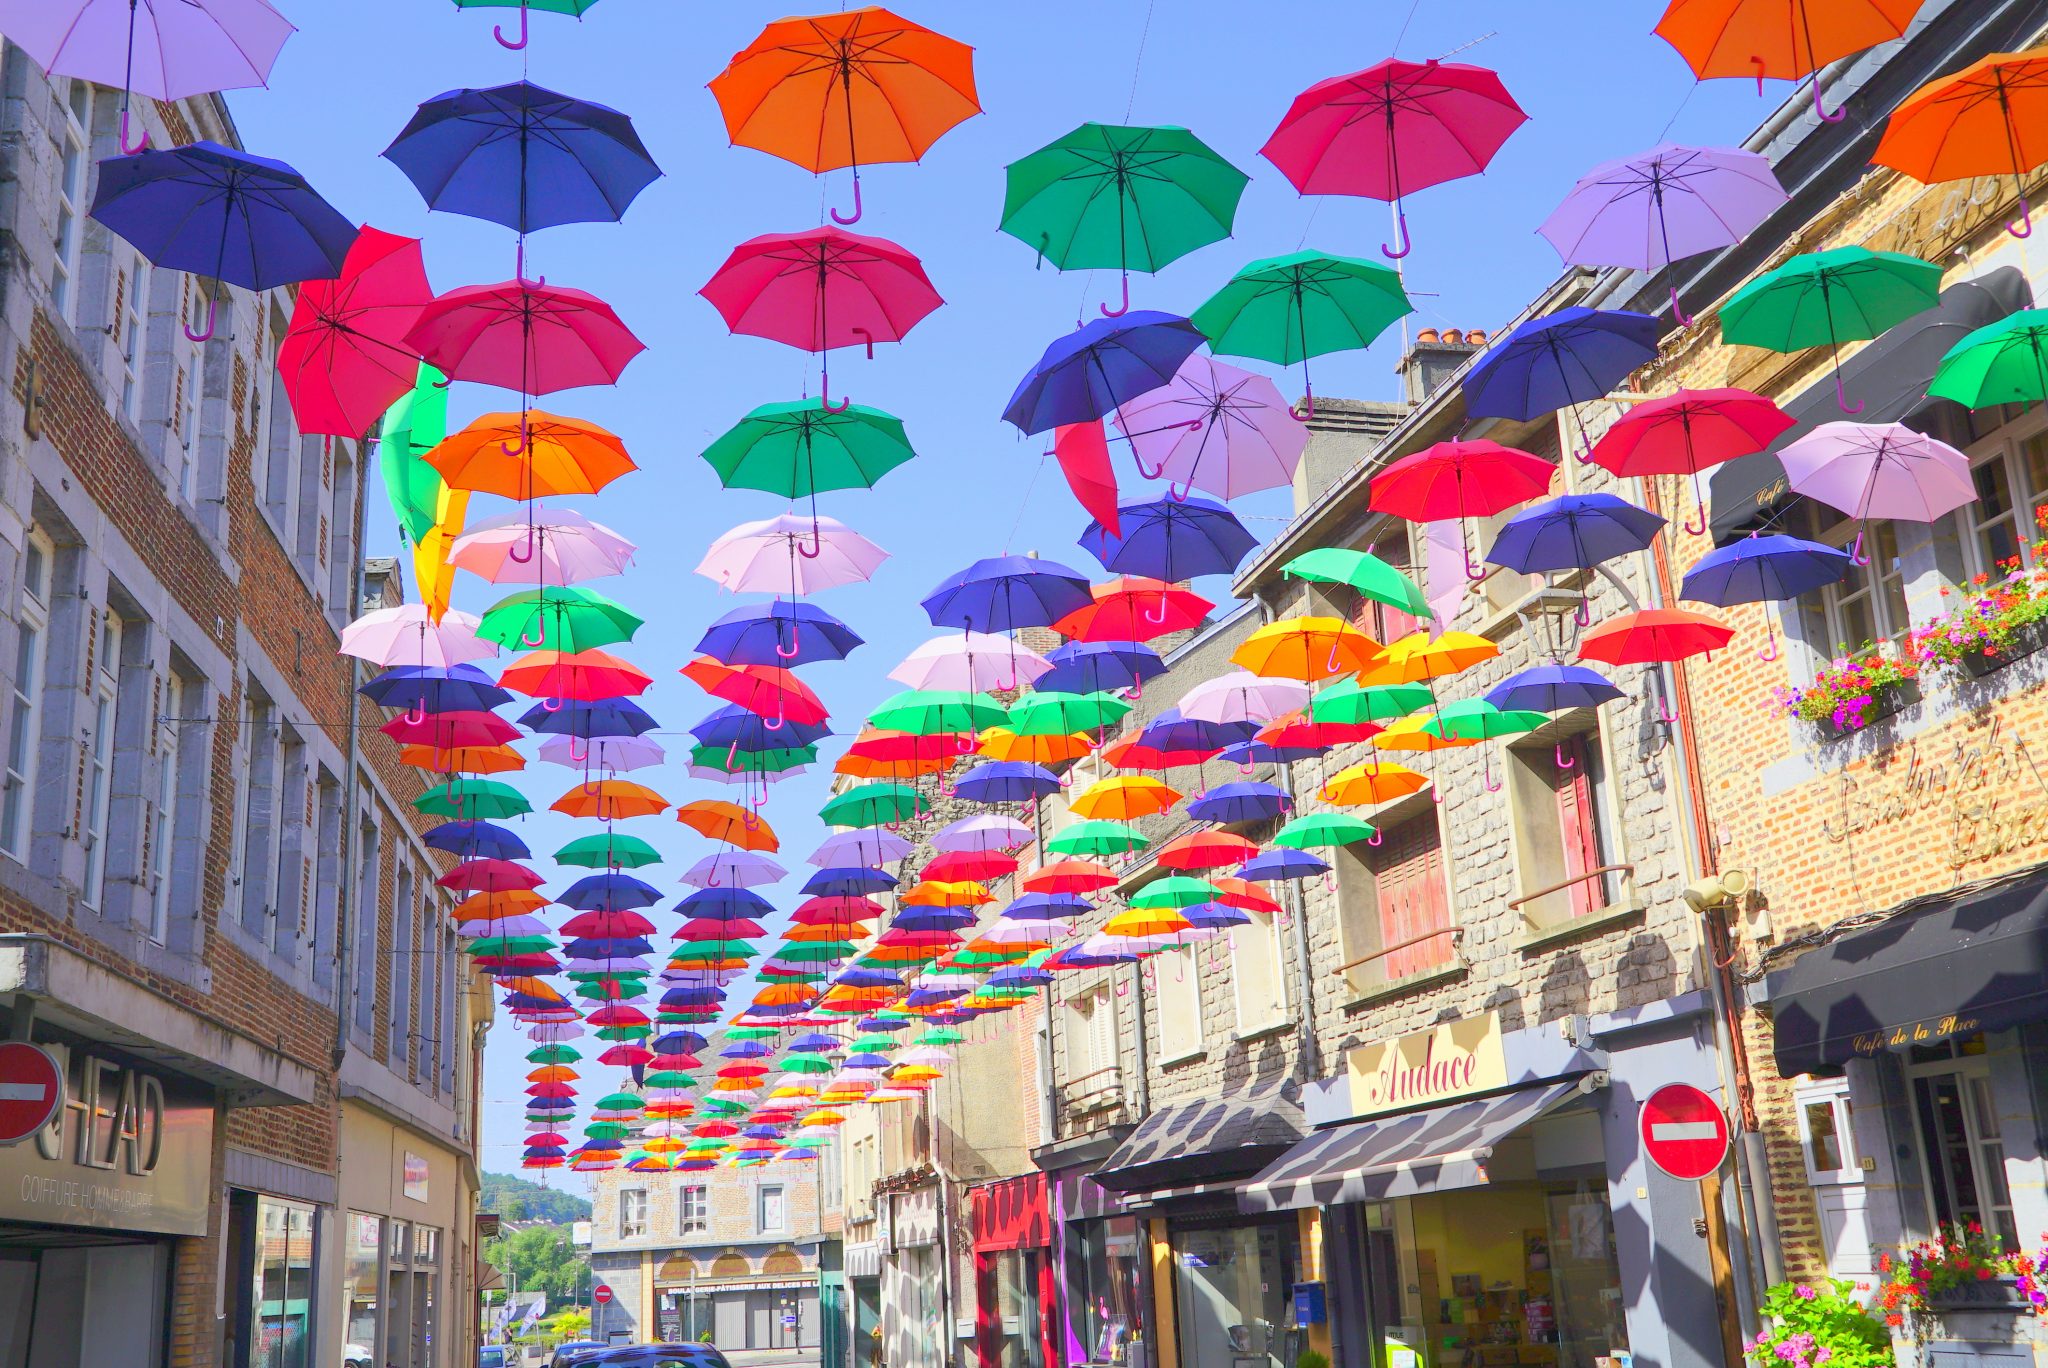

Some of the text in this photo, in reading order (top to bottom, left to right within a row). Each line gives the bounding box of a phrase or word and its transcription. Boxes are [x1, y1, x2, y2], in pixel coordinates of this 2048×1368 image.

[1756, 478, 1786, 506] Café
[1853, 1015, 1977, 1057] Café de la Place
[1371, 1034, 1477, 1105] Audace
[21, 1174, 79, 1208] COIFFURE
[802, 1280, 812, 1288] DE
